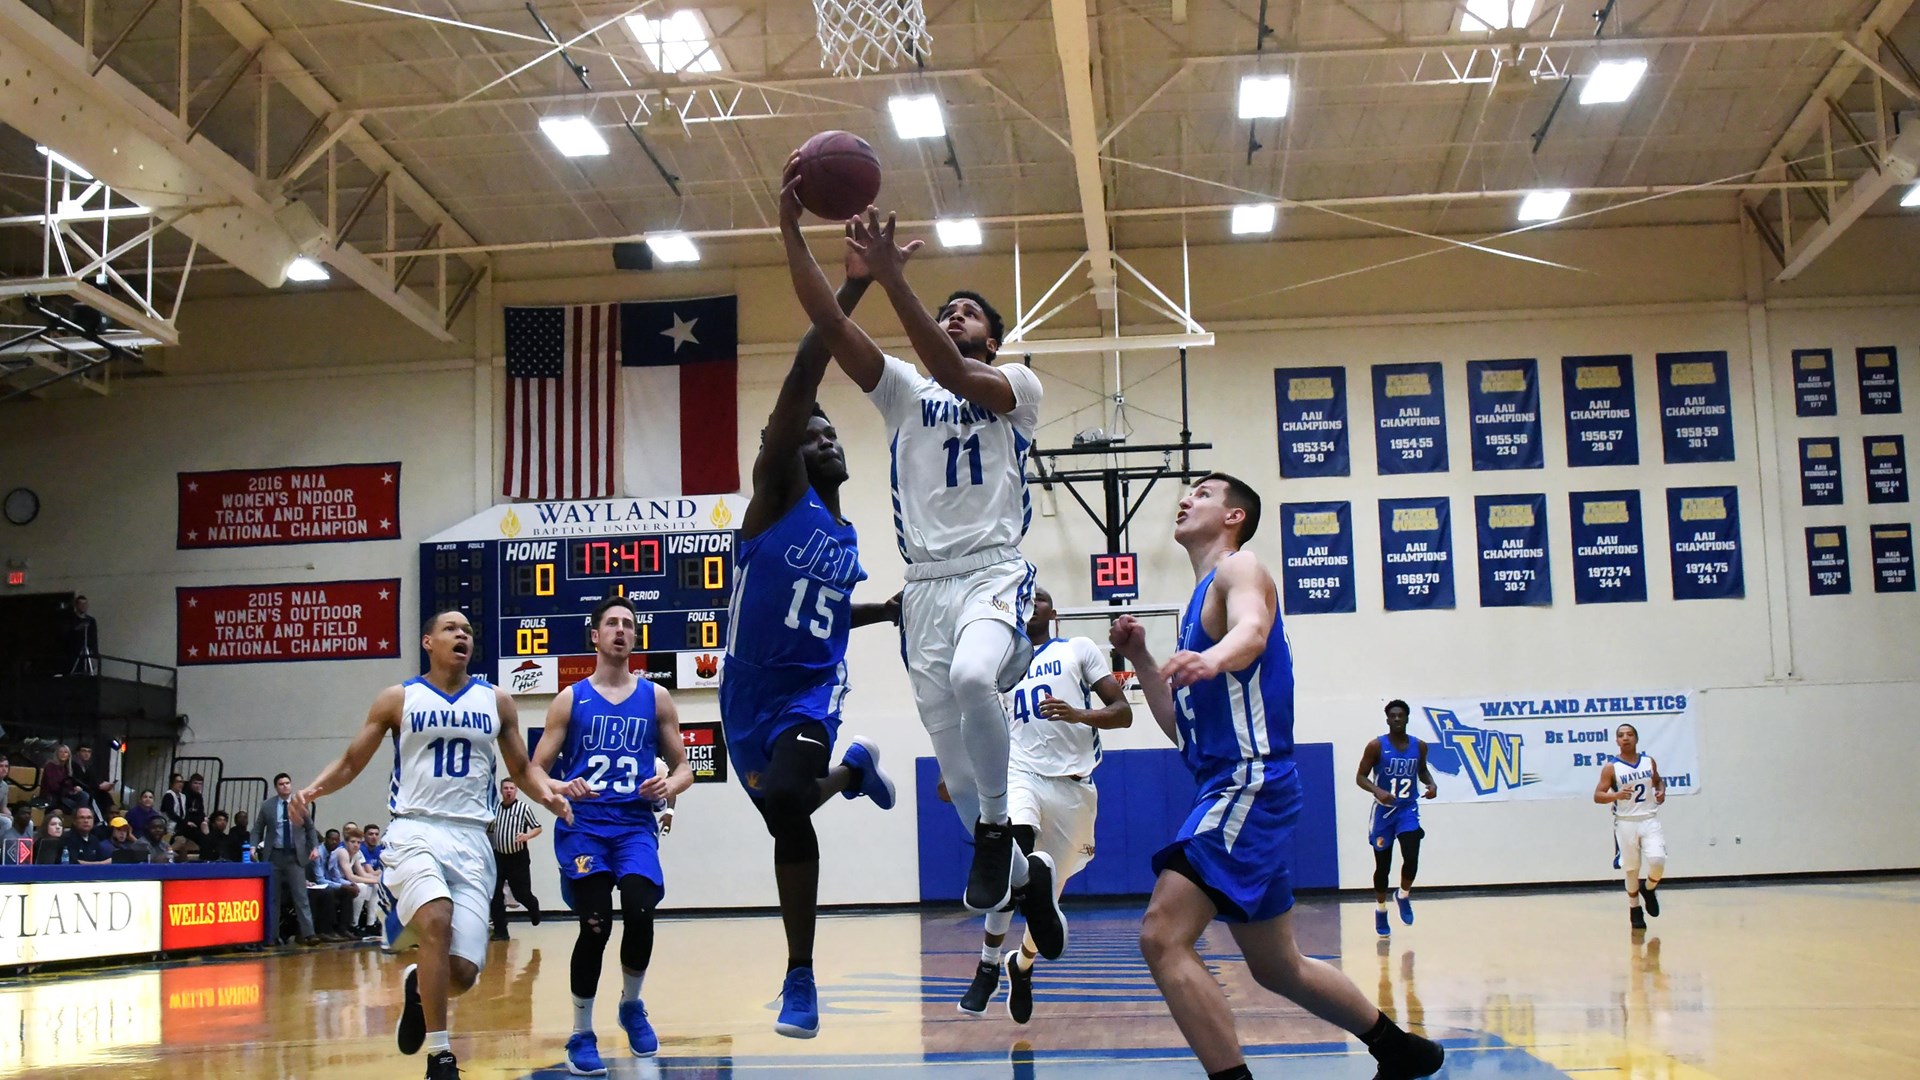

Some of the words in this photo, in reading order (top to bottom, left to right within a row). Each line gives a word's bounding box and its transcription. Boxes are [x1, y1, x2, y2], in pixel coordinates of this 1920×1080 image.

[1589, 400, 1610, 409] AAU
[1684, 396, 1706, 406] AAU
[1399, 408, 1420, 417] AAU
[1494, 404, 1515, 413] AAU
[1570, 409, 1630, 420] CHAMPIONS
[1666, 405, 1726, 417] CHAMPIONS
[1301, 411, 1322, 420] AAU
[1475, 412, 1535, 424] CHAMPIONS
[1282, 420, 1342, 431] CHAMPIONS
[1380, 416, 1440, 428] CHAMPIONS
[1485, 434, 1528, 445] 1955-56
[1581, 430, 1624, 442] 1956-57
[1292, 441, 1335, 453] 1953-54
[1390, 438, 1433, 449] 1954-55
[1401, 449, 1423, 459] 23-0
[1496, 445, 1518, 455] 23-0
[943, 433, 983, 488] 11
[1303, 453, 1325, 463] 29-0
[249, 477, 282, 491] 2016
[291, 474, 326, 489] NAIA
[222, 492, 288, 508] WOMEN'S
[297, 489, 353, 504] INDOOR
[215, 509, 264, 524] TRACK
[274, 507, 304, 521] AND
[312, 505, 357, 520] FIELD
[534, 499, 697, 525] WAYLAND
[208, 523, 282, 541] NATIONAL
[290, 520, 368, 537] CHAMPION
[533, 525, 593, 536] BAPTIST
[603, 521, 698, 533] UNIVERSITY
[1596, 536, 1618, 545] AAU
[1694, 532, 1716, 541] AAU
[667, 534, 732, 555] VISITOR
[1406, 543, 1428, 552] AAU
[1502, 539, 1524, 549] AAU
[1676, 541, 1736, 552] CHAMPIONS
[505, 541, 558, 561] HOME
[1306, 546, 1328, 556] AAU
[1483, 548, 1543, 560] CHAMPIONS
[1578, 545, 1638, 556] CHAMPIONS
[584, 540, 659, 575] 17:47
[1288, 556, 1348, 567] CHAMPIONS
[1387, 552, 1447, 563] CHAMPIONS
[703, 556, 723, 589] 0
[1096, 556, 1134, 586] 28
[1588, 567, 1631, 578] 1973-74
[1686, 562, 1728, 574] 1974-75
[535, 563, 555, 596] 0
[1396, 573, 1440, 585] 1969-70
[1494, 570, 1535, 582] 1970-71
[1698, 574, 1718, 584] 34-1
[1298, 577, 1340, 589] 1960-61
[1505, 582, 1526, 591] 30-2
[1599, 578, 1621, 588] 34-4
[628, 590, 660, 601] PERIOD
[1308, 589, 1330, 599] 24-2
[1408, 585, 1429, 595] 27-3
[248, 592, 283, 607] 2015
[291, 590, 327, 605] NAIA
[214, 607, 281, 624] WOMEN'S
[290, 604, 362, 621] OUTDOOR
[783, 578, 844, 640] 15
[520, 618, 546, 628] FOULS
[634, 614, 654, 624] ULS
[687, 612, 716, 622] FOULS
[215, 625, 264, 641] TRACK
[274, 623, 304, 638] AND
[313, 621, 358, 637] FIELD
[702, 621, 718, 648] 0
[208, 640, 282, 657] NATIONAL
[291, 637, 368, 653] CHAMPION
[516, 628, 549, 655] 02
[559, 666, 593, 675] WELLS
[1026, 659, 1062, 680] LAND
[512, 670, 544, 688] Pizza
[518, 679, 539, 691] Hut
[1014, 683, 1053, 724] 40
[1480, 701, 1580, 717] WAYLAND
[1584, 695, 1687, 713] ATHLETICS
[411, 710, 492, 735] WAYLAND
[582, 715, 648, 753] JBU
[427, 737, 472, 778] 10
[685, 745, 714, 760] TECT
[689, 760, 716, 771] OUSE.
[1384, 758, 1418, 776] JBU
[587, 754, 639, 794] 23
[1619, 769, 1652, 784] WAYLAN
[1390, 778, 1412, 798] 12
[1634, 783, 1646, 803] 2
[168, 903, 215, 927] WELLS
[217, 900, 259, 923] FARGO
